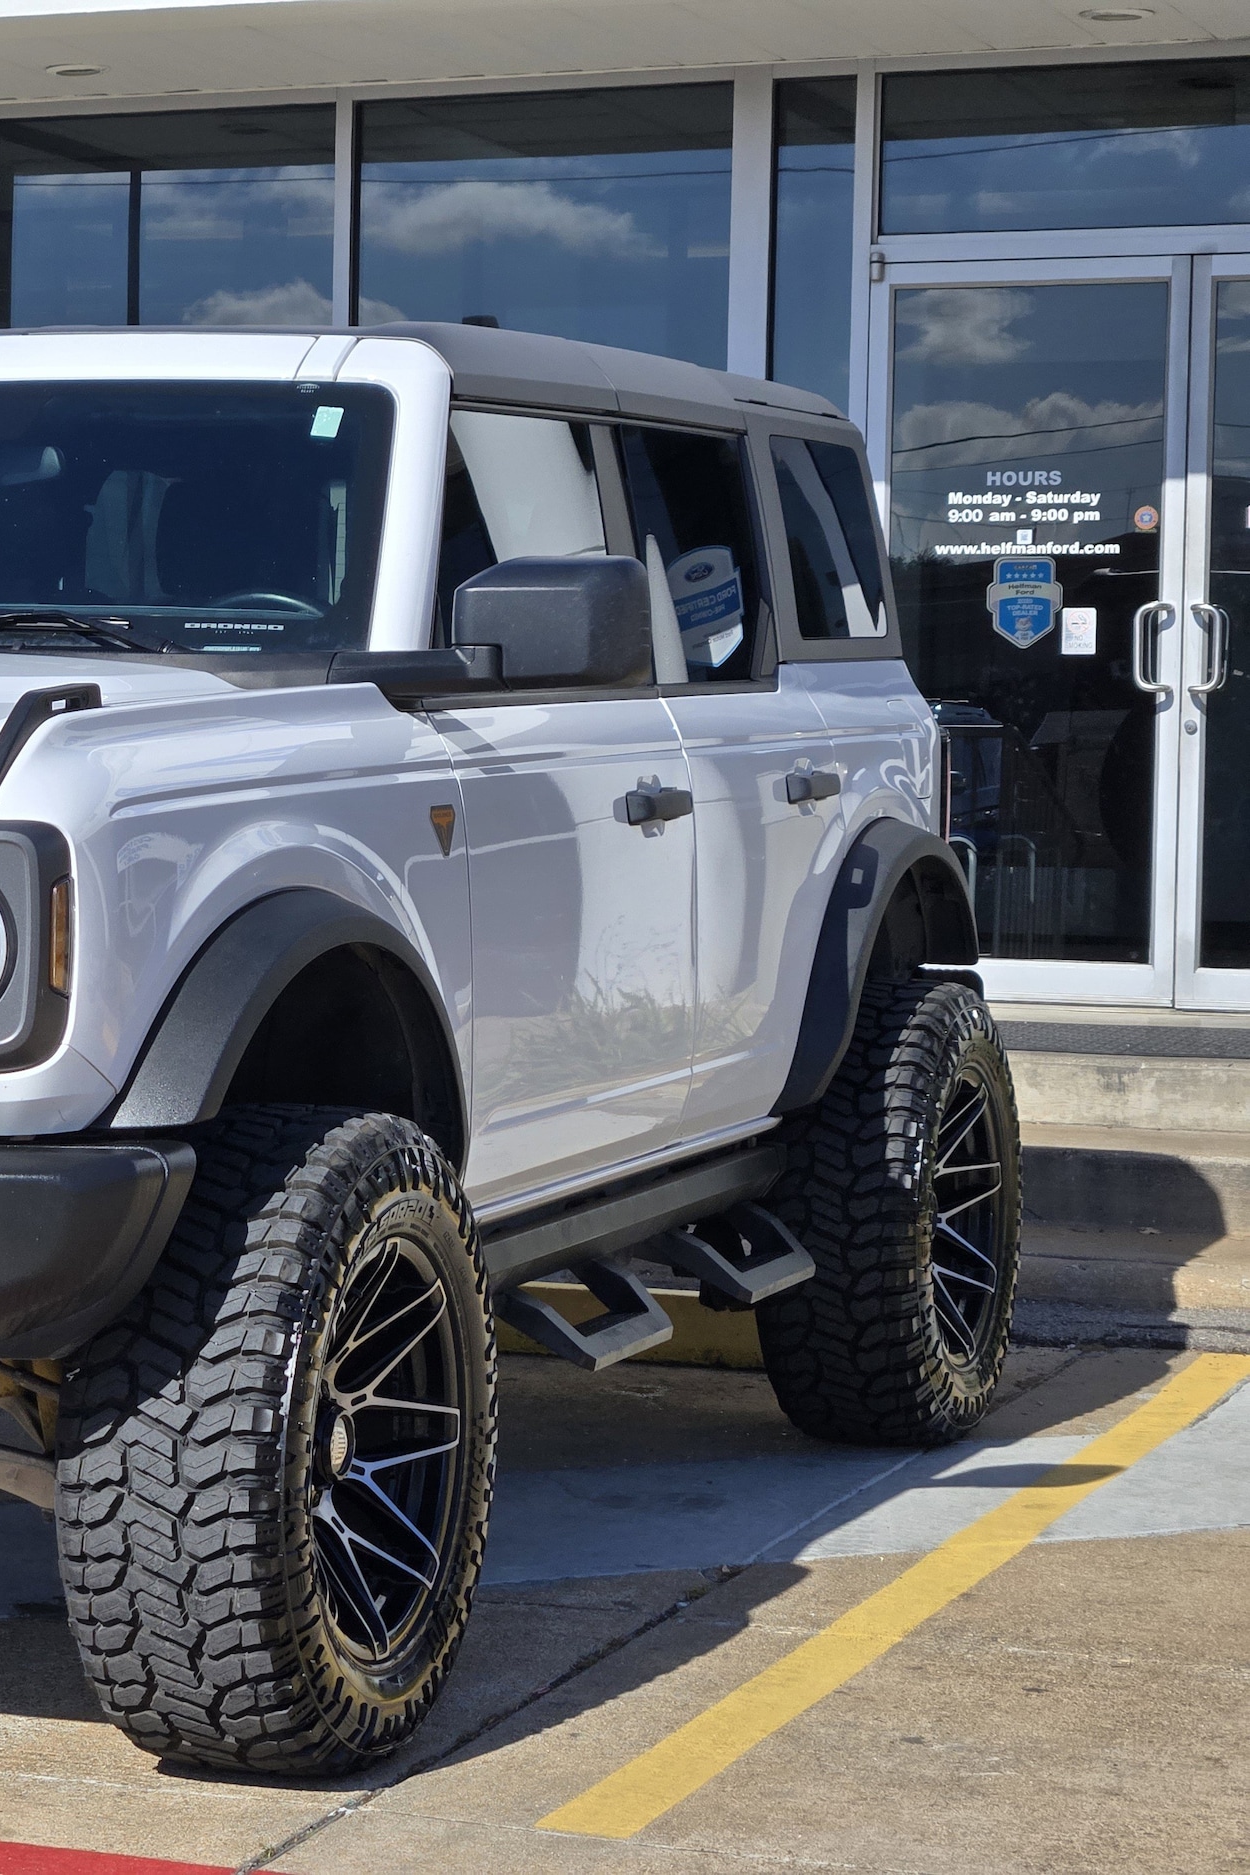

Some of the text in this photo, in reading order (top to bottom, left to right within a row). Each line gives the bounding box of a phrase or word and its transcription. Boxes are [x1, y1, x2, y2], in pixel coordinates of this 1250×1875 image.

[986, 470, 1062, 486] HOURS
[948, 491, 1011, 507] Monday
[1025, 490, 1101, 507] Saturday
[948, 509, 983, 523] 9:00
[989, 511, 1016, 523] am
[1031, 508, 1068, 523] 9:00
[1073, 510, 1101, 524] pm
[935, 542, 1120, 555] www.helfmanford.com
[184, 622, 284, 631] BRONCO
